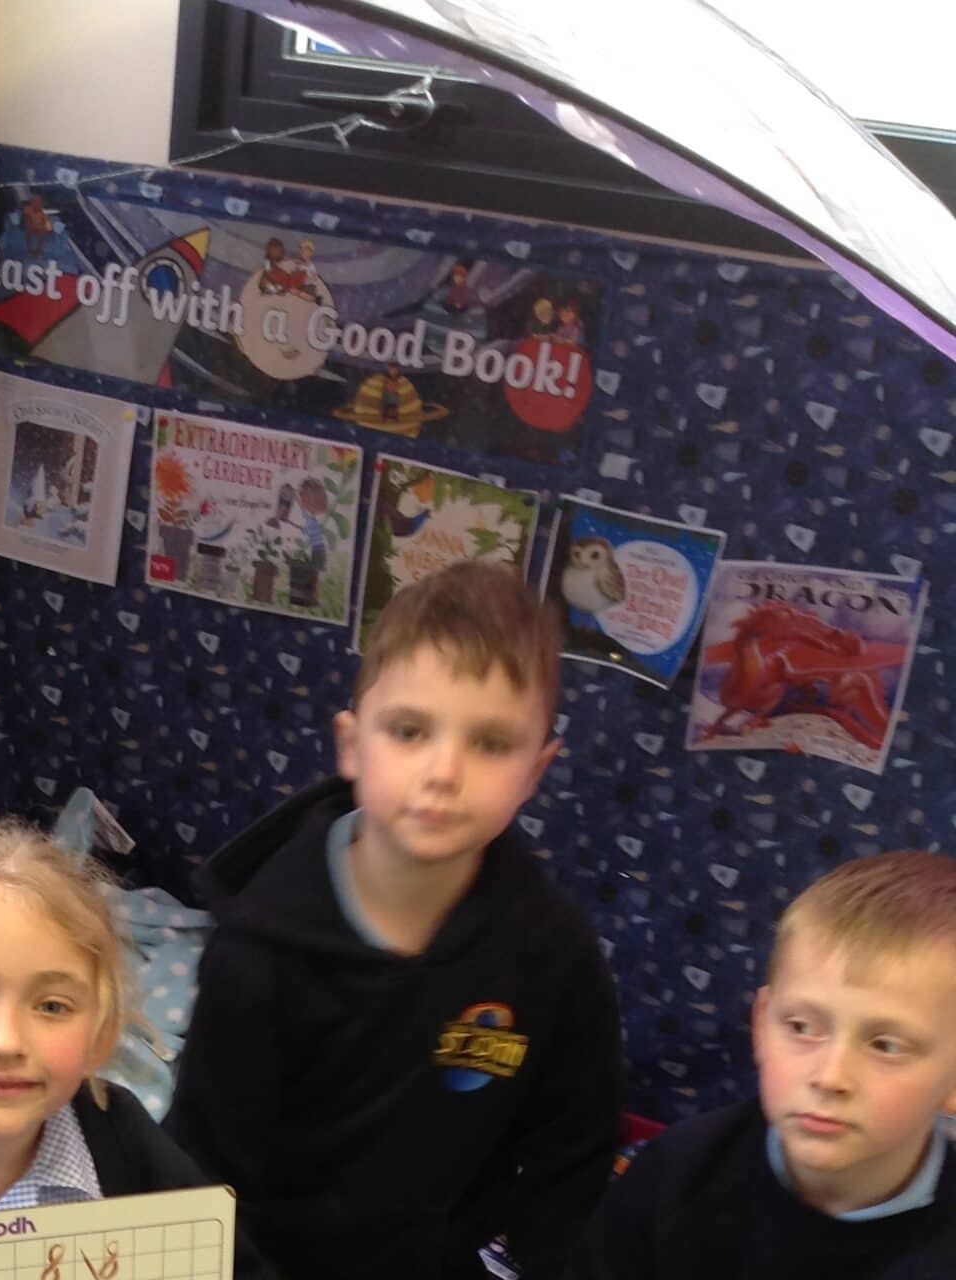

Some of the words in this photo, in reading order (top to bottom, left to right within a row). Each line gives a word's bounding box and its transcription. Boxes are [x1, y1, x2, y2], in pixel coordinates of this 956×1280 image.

[76, 263, 140, 327] off
[149, 276, 245, 336] with
[262, 309, 288, 343] a
[306, 305, 427, 369] Good
[441, 330, 583, 399] Book!
[174, 417, 313, 471] EXTRAORDINARY
[202, 456, 274, 491] GARDENER
